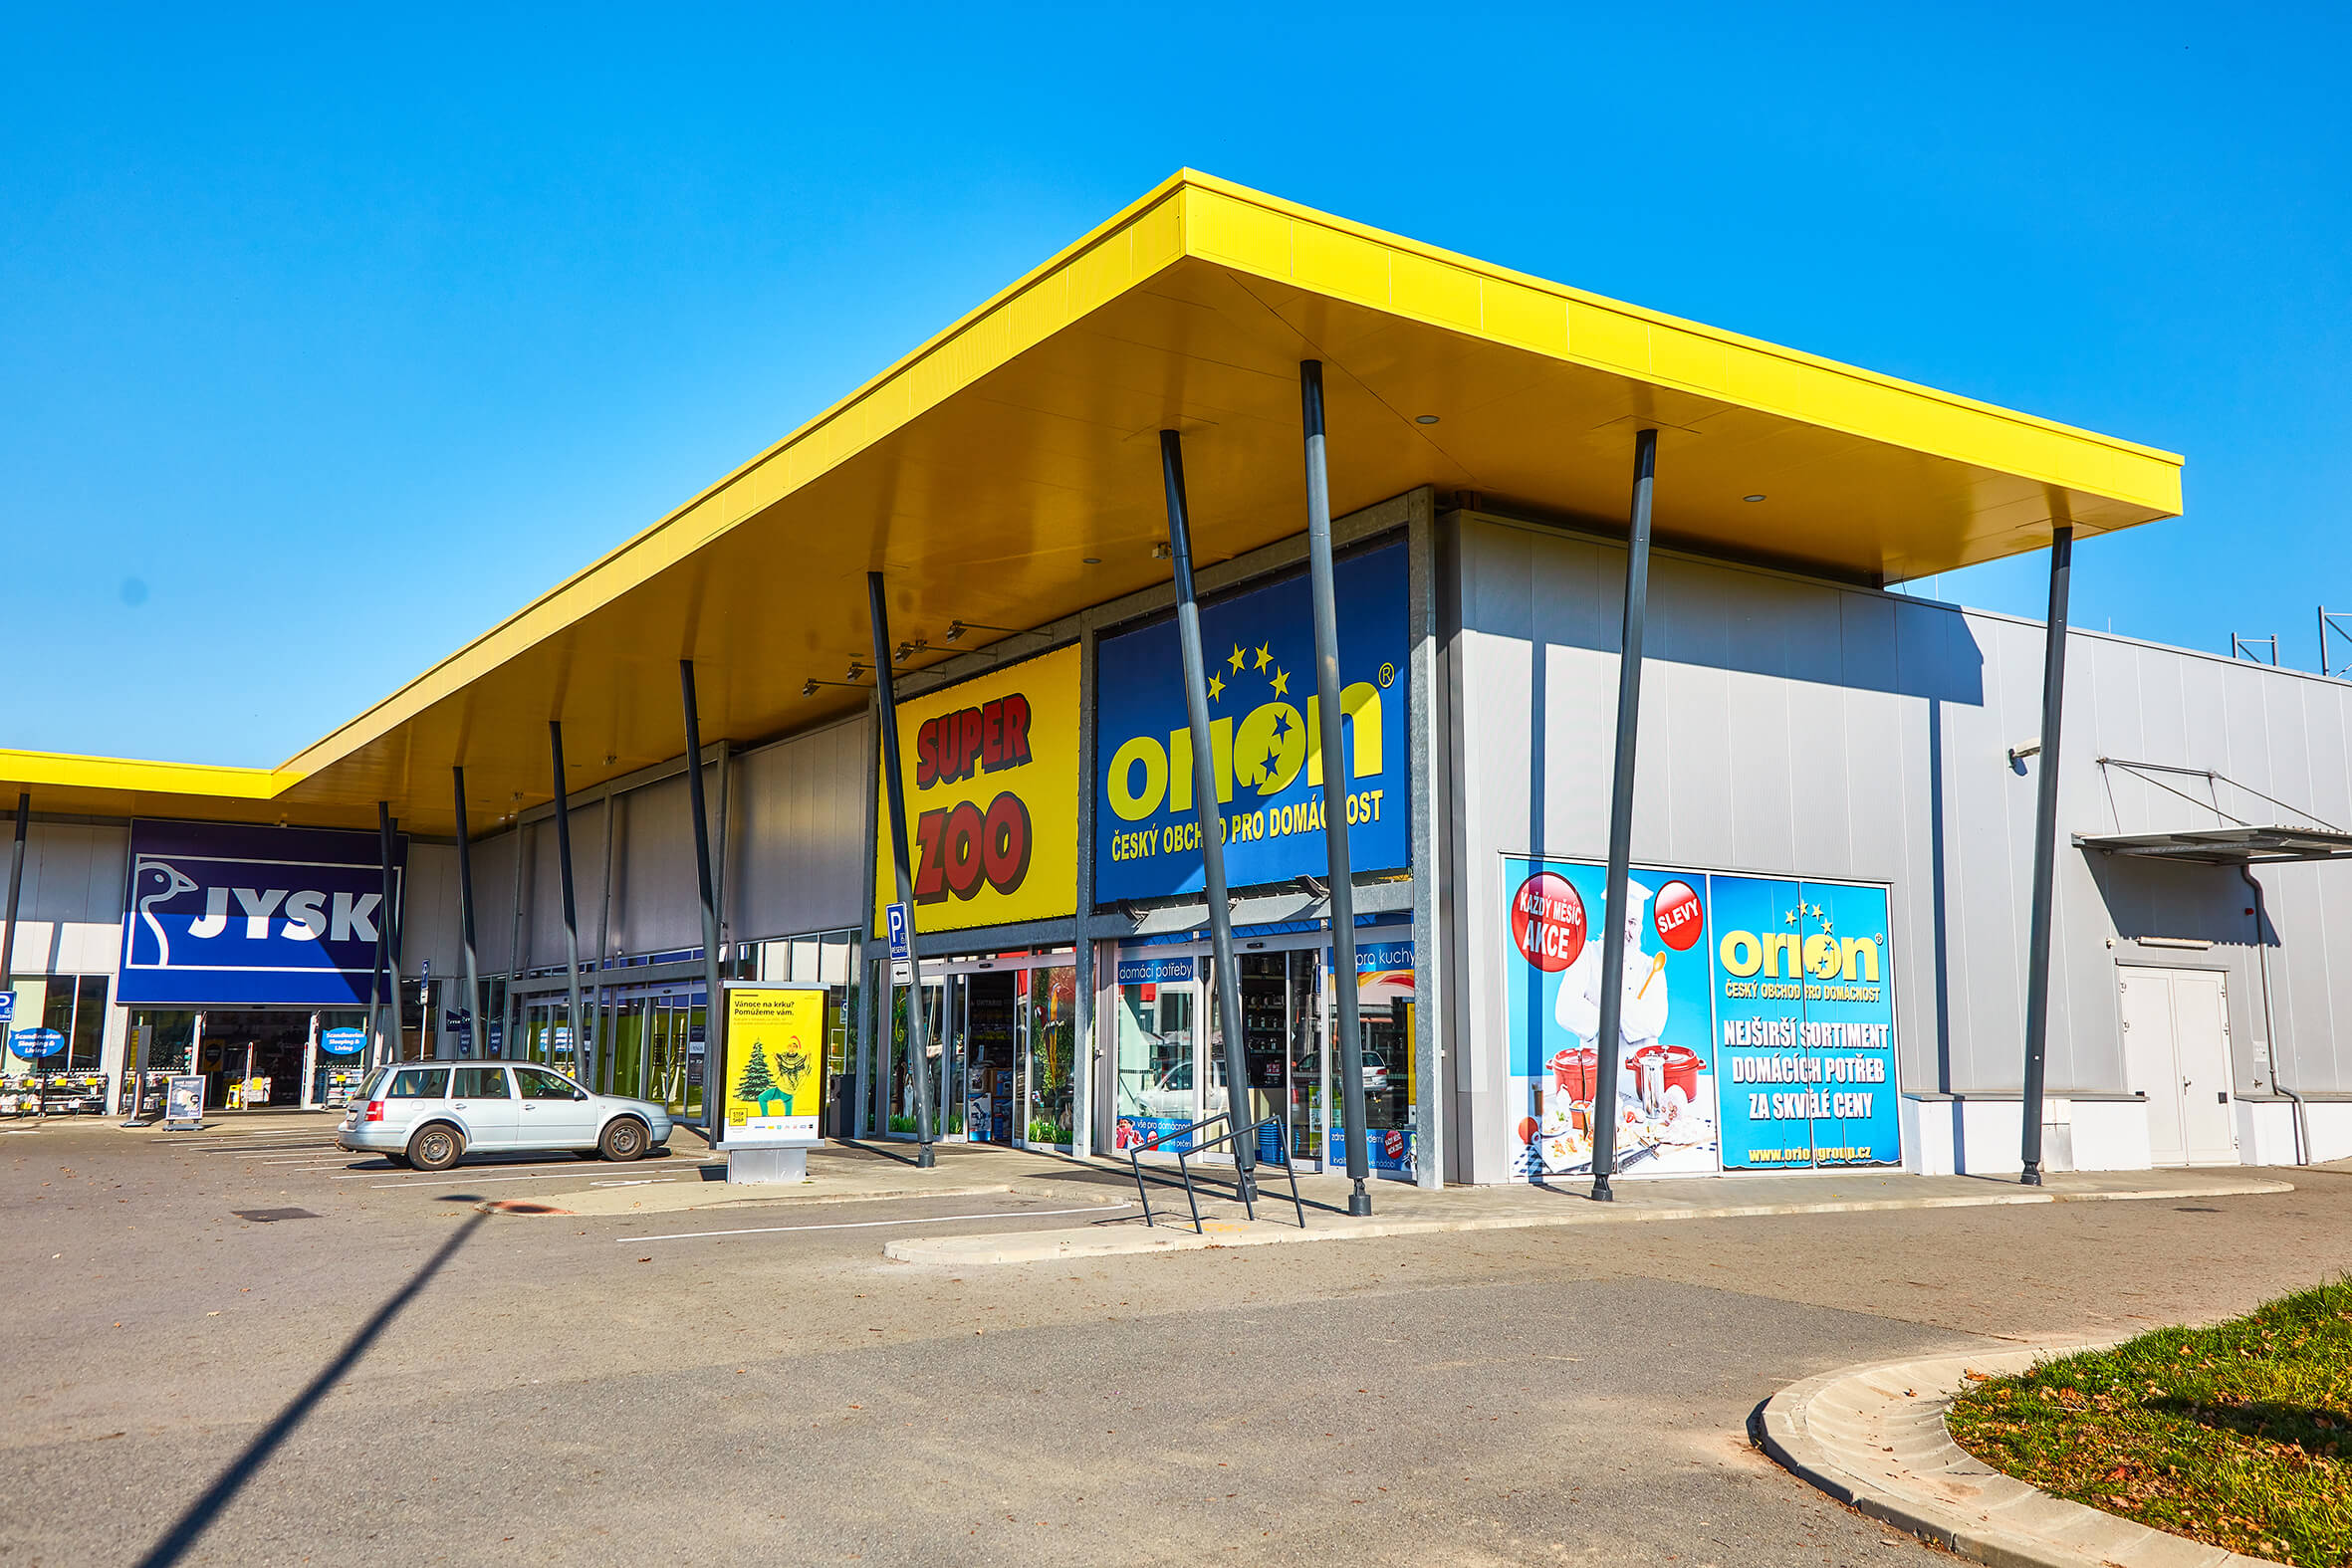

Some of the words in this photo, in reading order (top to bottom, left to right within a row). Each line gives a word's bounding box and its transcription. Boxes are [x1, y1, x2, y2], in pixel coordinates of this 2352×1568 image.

[917, 693, 1033, 790] SUPER
[1107, 682, 1383, 821] orion
[1112, 822, 1158, 862] ČESKÝ
[1163, 818, 1227, 853] OBCHD
[1232, 810, 1265, 844] PRO
[1270, 789, 1384, 837] DOMÁCOST
[913, 790, 1032, 906] ZOO
[187, 886, 383, 943] JYSK
[1520, 891, 1551, 919] KAŽDÝ
[1552, 897, 1582, 926] MĚSÍC
[1657, 898, 1700, 934] SLEVY
[890, 911, 902, 943] P
[1522, 919, 1571, 960] AKCE
[1119, 963, 1155, 980] domácí
[1155, 962, 1193, 981] potřeby
[1720, 930, 1881, 983] orion
[1726, 979, 1759, 1000] ČESKÝ
[1761, 983, 1801, 1001] OBCHOD
[1805, 984, 1821, 1001] PRO
[1823, 984, 1880, 1003] DOMÁCNOST
[1724, 1015, 1798, 1048] NEJŠIRŠÍ
[1799, 1021, 1889, 1049] SORTIMENT
[1732, 1052, 1822, 1084] DOMÁCÍCH
[1824, 1052, 1885, 1084] POTŘEB
[1749, 1093, 1770, 1120] ZA
[1772, 1088, 1831, 1120] SKVĚLÉ
[1833, 1092, 1873, 1119] CENY
[1137, 1119, 1146, 1129] vše
